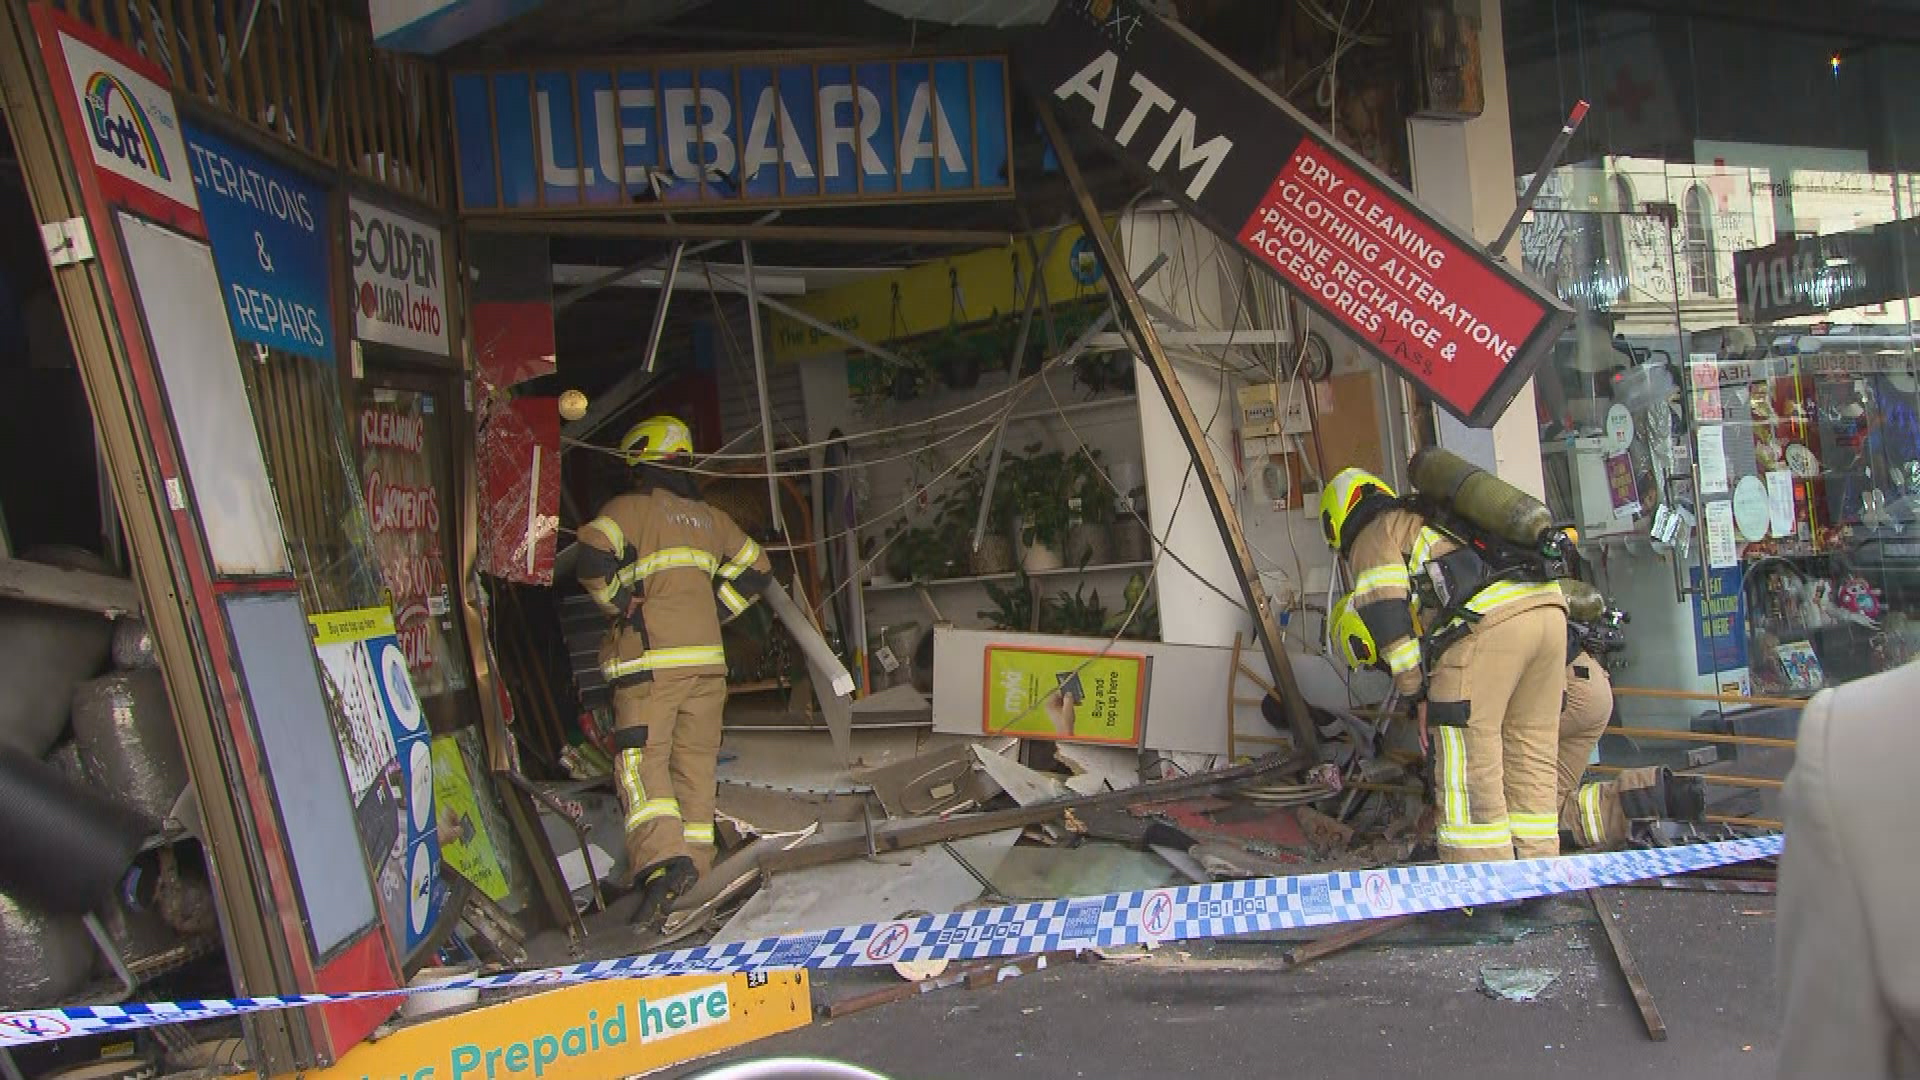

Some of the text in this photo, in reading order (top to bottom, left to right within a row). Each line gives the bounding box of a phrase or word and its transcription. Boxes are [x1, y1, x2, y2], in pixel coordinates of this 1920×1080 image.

[84, 97, 147, 169] Lott
[538, 81, 967, 187] LEBARA
[1053, 50, 1234, 202] ATM
[190, 142, 314, 232] TERATIONS
[1299, 156, 1445, 268] DRY CLEANING
[254, 231, 274, 272] &
[351, 209, 437, 289] GOLDEN
[1250, 229, 1382, 332] ACCESSORIES
[1263, 208, 1457, 362] PHONE RECHARGE &
[1282, 184, 1517, 363] CLOTHING ALTERATIONS
[232, 283, 324, 346] REPAIRS
[1092, 678, 1106, 718] Buy and
[1106, 709, 1119, 727] top
[1107, 671, 1119, 696] here
[450, 988, 729, 1080] Prepaid here
